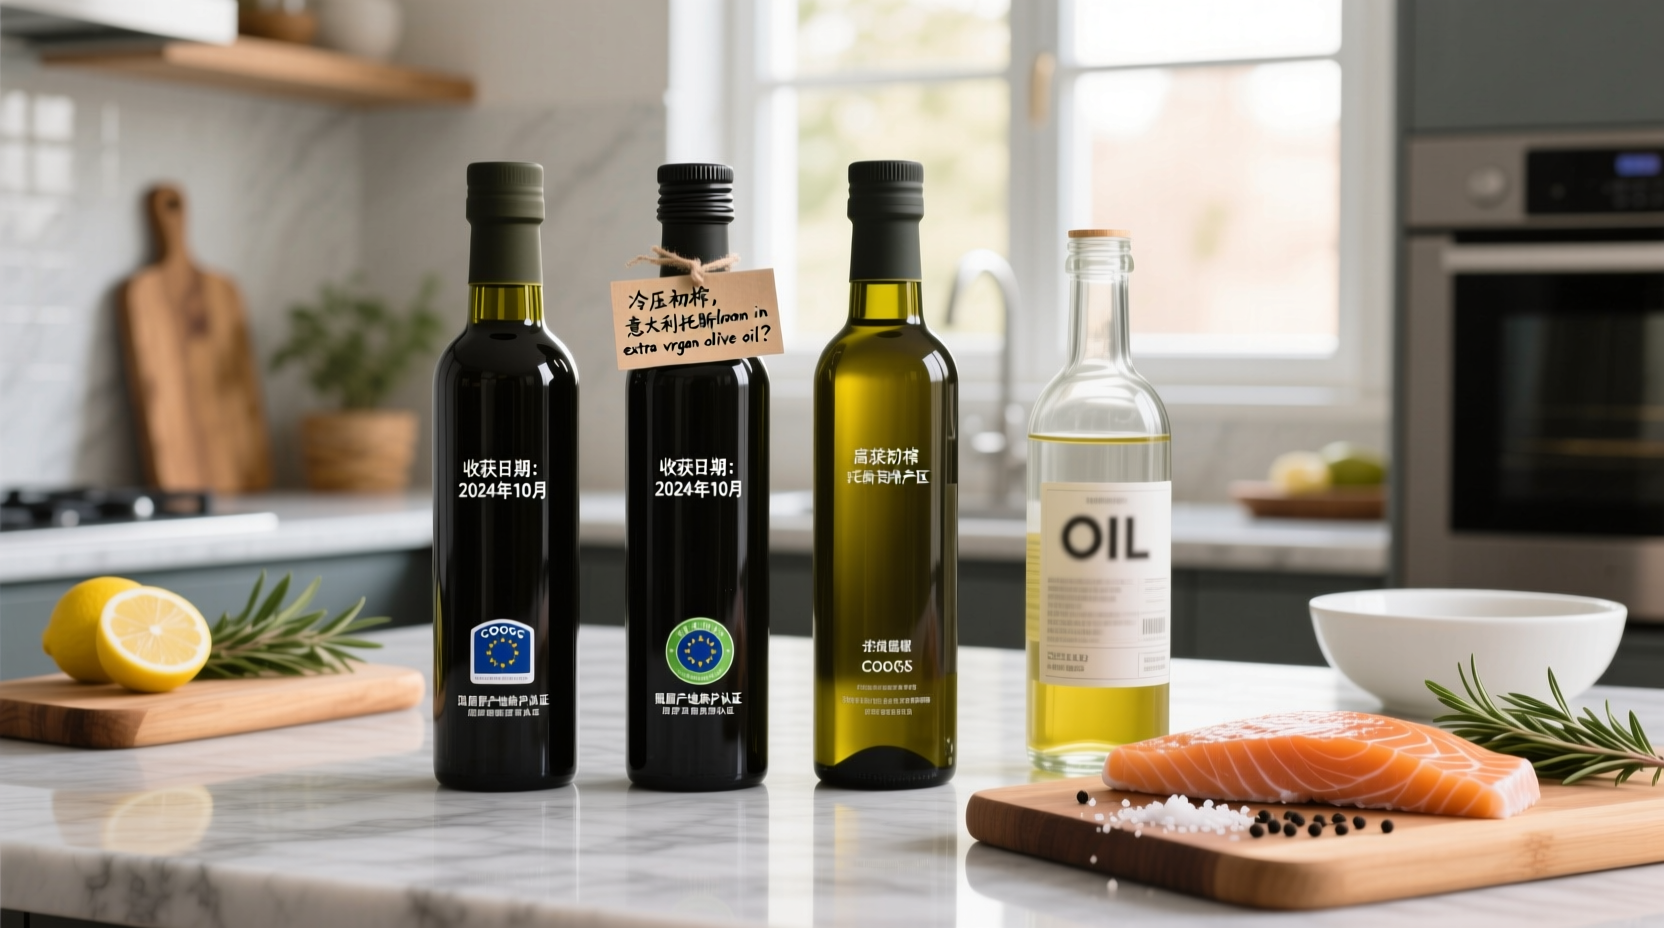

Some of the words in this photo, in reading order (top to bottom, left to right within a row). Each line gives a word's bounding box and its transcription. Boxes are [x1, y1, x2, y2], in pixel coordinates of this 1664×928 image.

[754, 305, 768, 319] in
[623, 342, 657, 356] extra
[704, 331, 737, 347] olive
[742, 324, 771, 343] oil?
[458, 480, 547, 500] 2024年10月
[654, 479, 742, 499] 2024年10月
[1061, 514, 1149, 561] OIL
